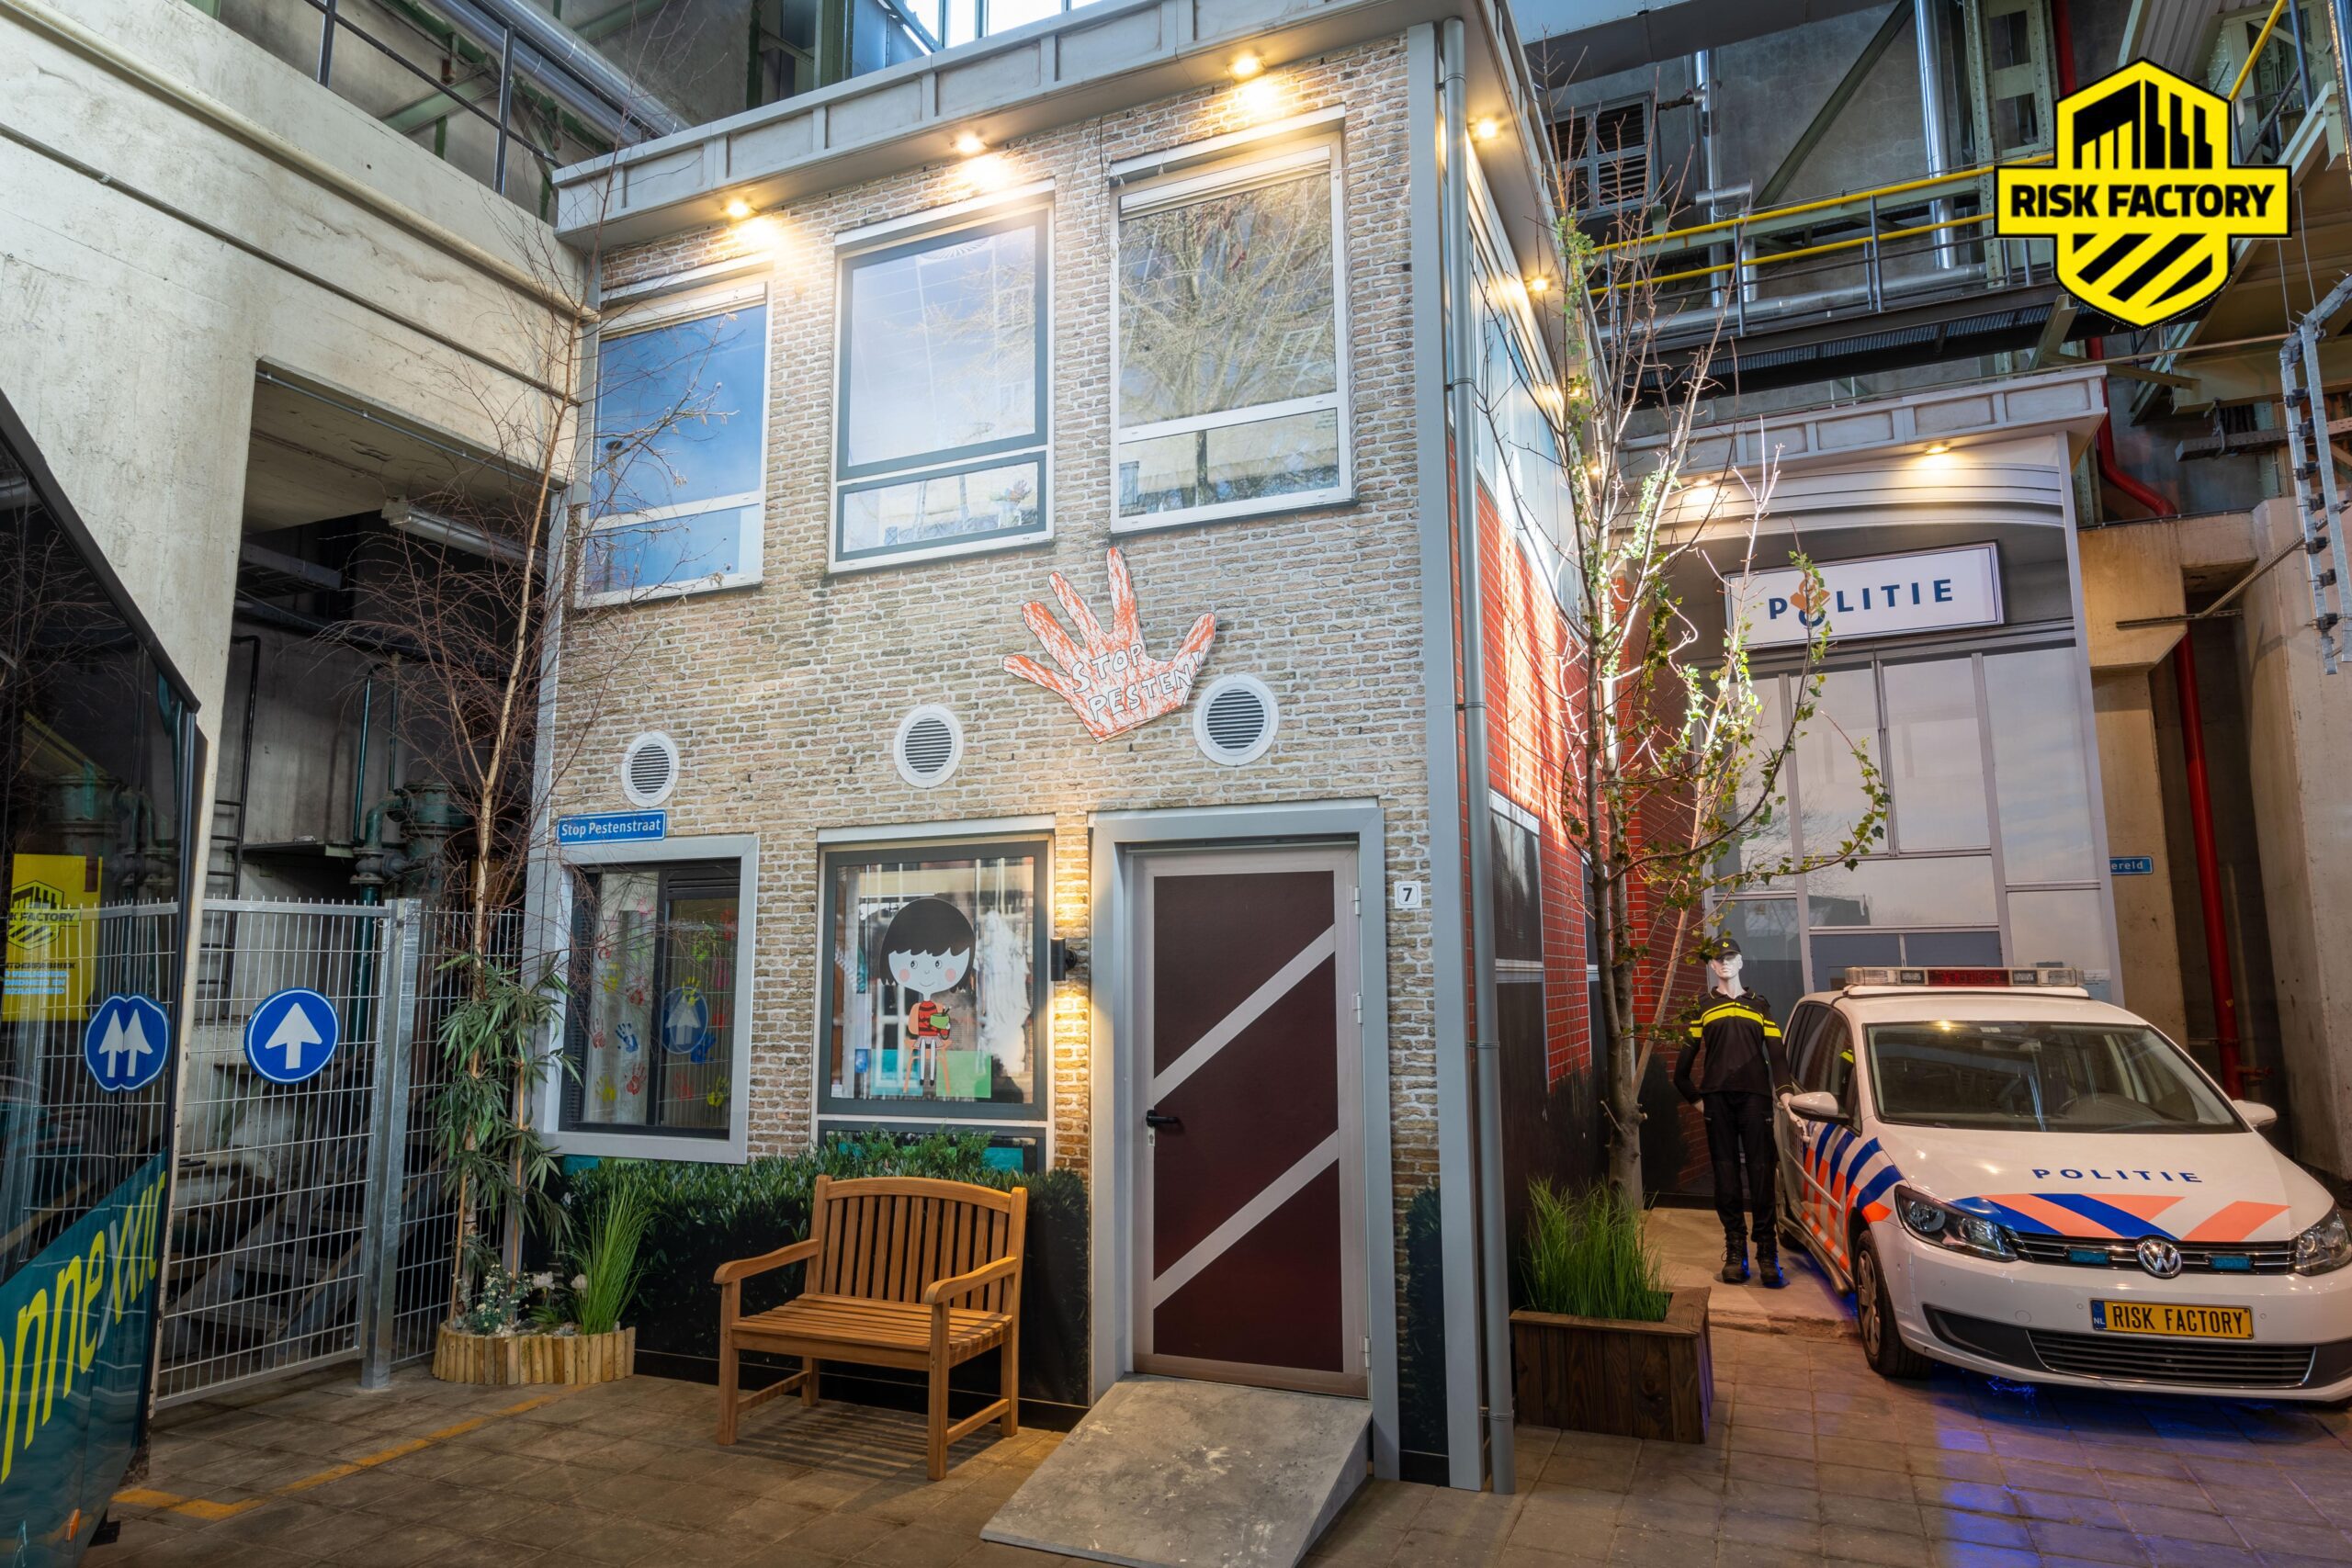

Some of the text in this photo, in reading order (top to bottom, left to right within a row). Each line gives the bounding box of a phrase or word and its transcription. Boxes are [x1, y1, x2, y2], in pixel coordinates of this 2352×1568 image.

[1072, 643, 1143, 694] STOP
[561, 818, 662, 838] Stop Pestenstraat
[1402, 887, 1413, 902] 7
[20, 912, 75, 922] FACTORY
[2031, 1168, 2203, 1183] POLITIE
[2113, 1305, 2155, 1330] RISK
[2165, 1308, 2243, 1334] FACTORY
